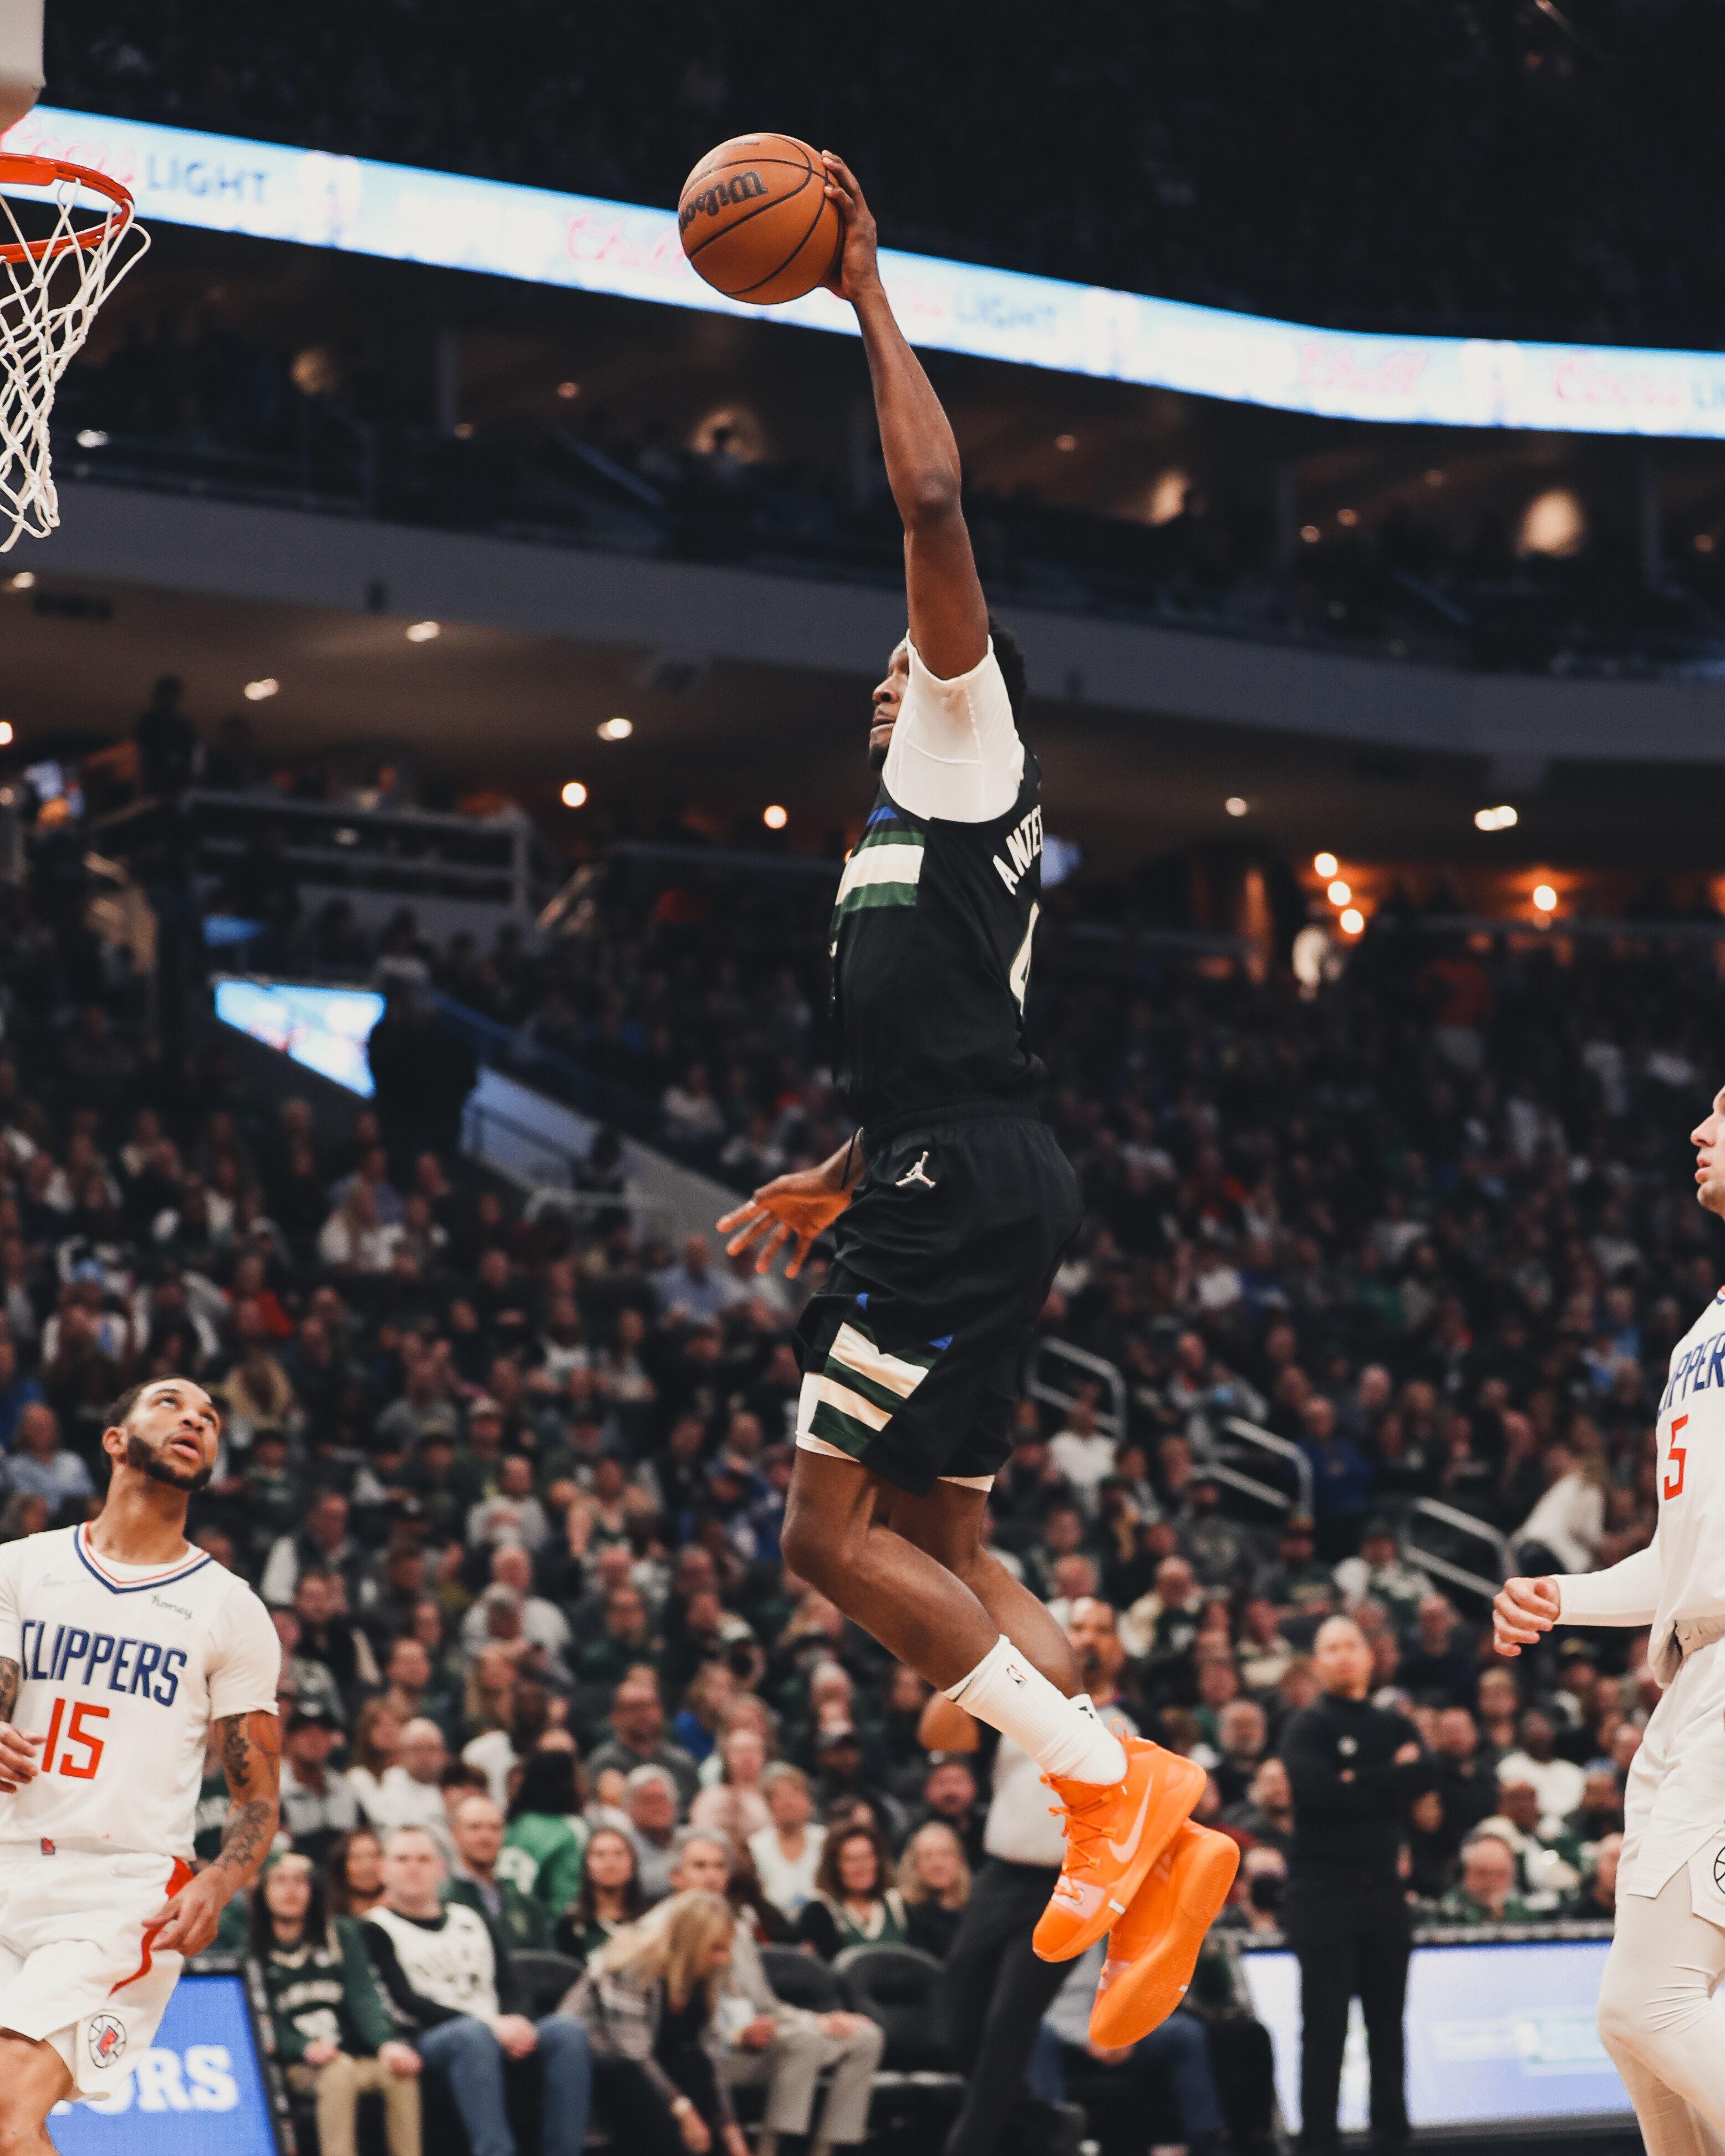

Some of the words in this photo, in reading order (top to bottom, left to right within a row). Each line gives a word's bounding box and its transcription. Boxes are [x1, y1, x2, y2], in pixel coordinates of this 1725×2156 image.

[146, 152, 268, 205] LIGHT
[1663, 1414, 1688, 1501] 5
[22, 1619, 187, 1707] CLIPPERS
[41, 1698, 110, 1780] 15
